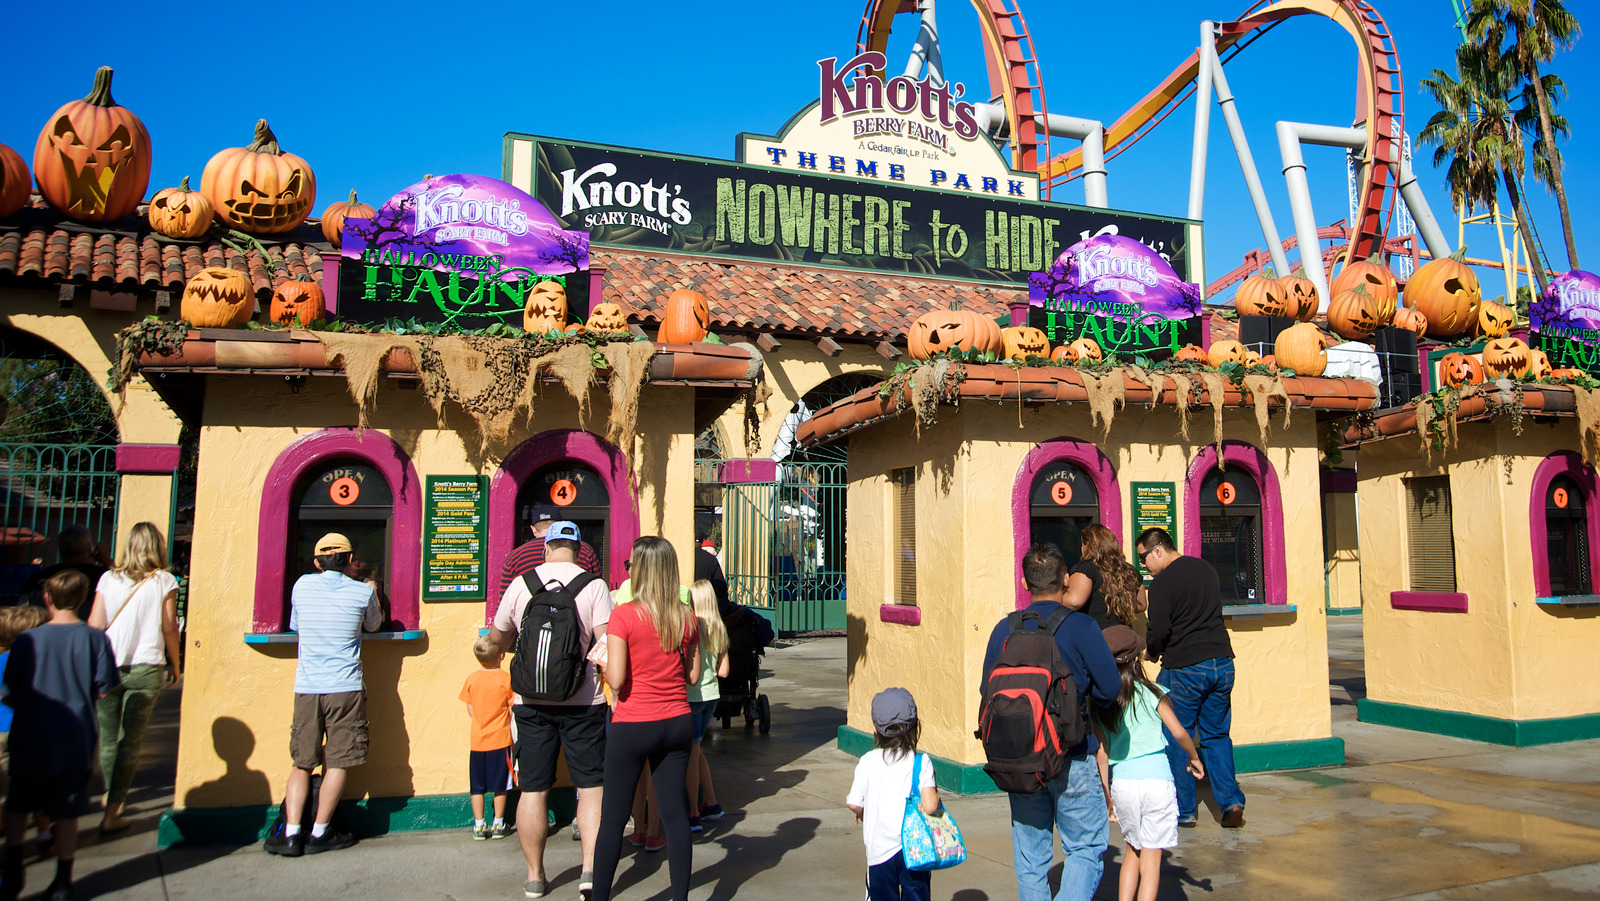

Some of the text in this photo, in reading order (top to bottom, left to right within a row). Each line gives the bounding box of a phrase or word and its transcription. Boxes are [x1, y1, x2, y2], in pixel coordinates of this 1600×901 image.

[817, 51, 980, 139] Knott's
[853, 118, 948, 149] BERRY FARM
[858, 140, 865, 149] A
[922, 149, 939, 160] Park
[766, 146, 1025, 196] THEME PARK
[560, 162, 692, 226] Knott's
[412, 184, 529, 237] Knott's
[585, 211, 669, 236] SCARY FARM
[715, 177, 914, 261] NOWHERE
[928, 209, 969, 269] to
[434, 224, 510, 247] SCARY FARM
[364, 248, 502, 271] HALLOWEEN
[1076, 243, 1158, 288] Knott's
[1045, 298, 1143, 316] HALLOWEEN
[1046, 312, 1188, 354] HAUNT
[322, 468, 366, 484] OPEN
[545, 471, 586, 485] OPEN
[1045, 470, 1076, 483] OPEN
[339, 484, 350, 498] 3
[557, 486, 568, 499] 4
[1058, 487, 1066, 499] 5
[1222, 488, 1230, 499] 6
[1558, 493, 1563, 503] 7
